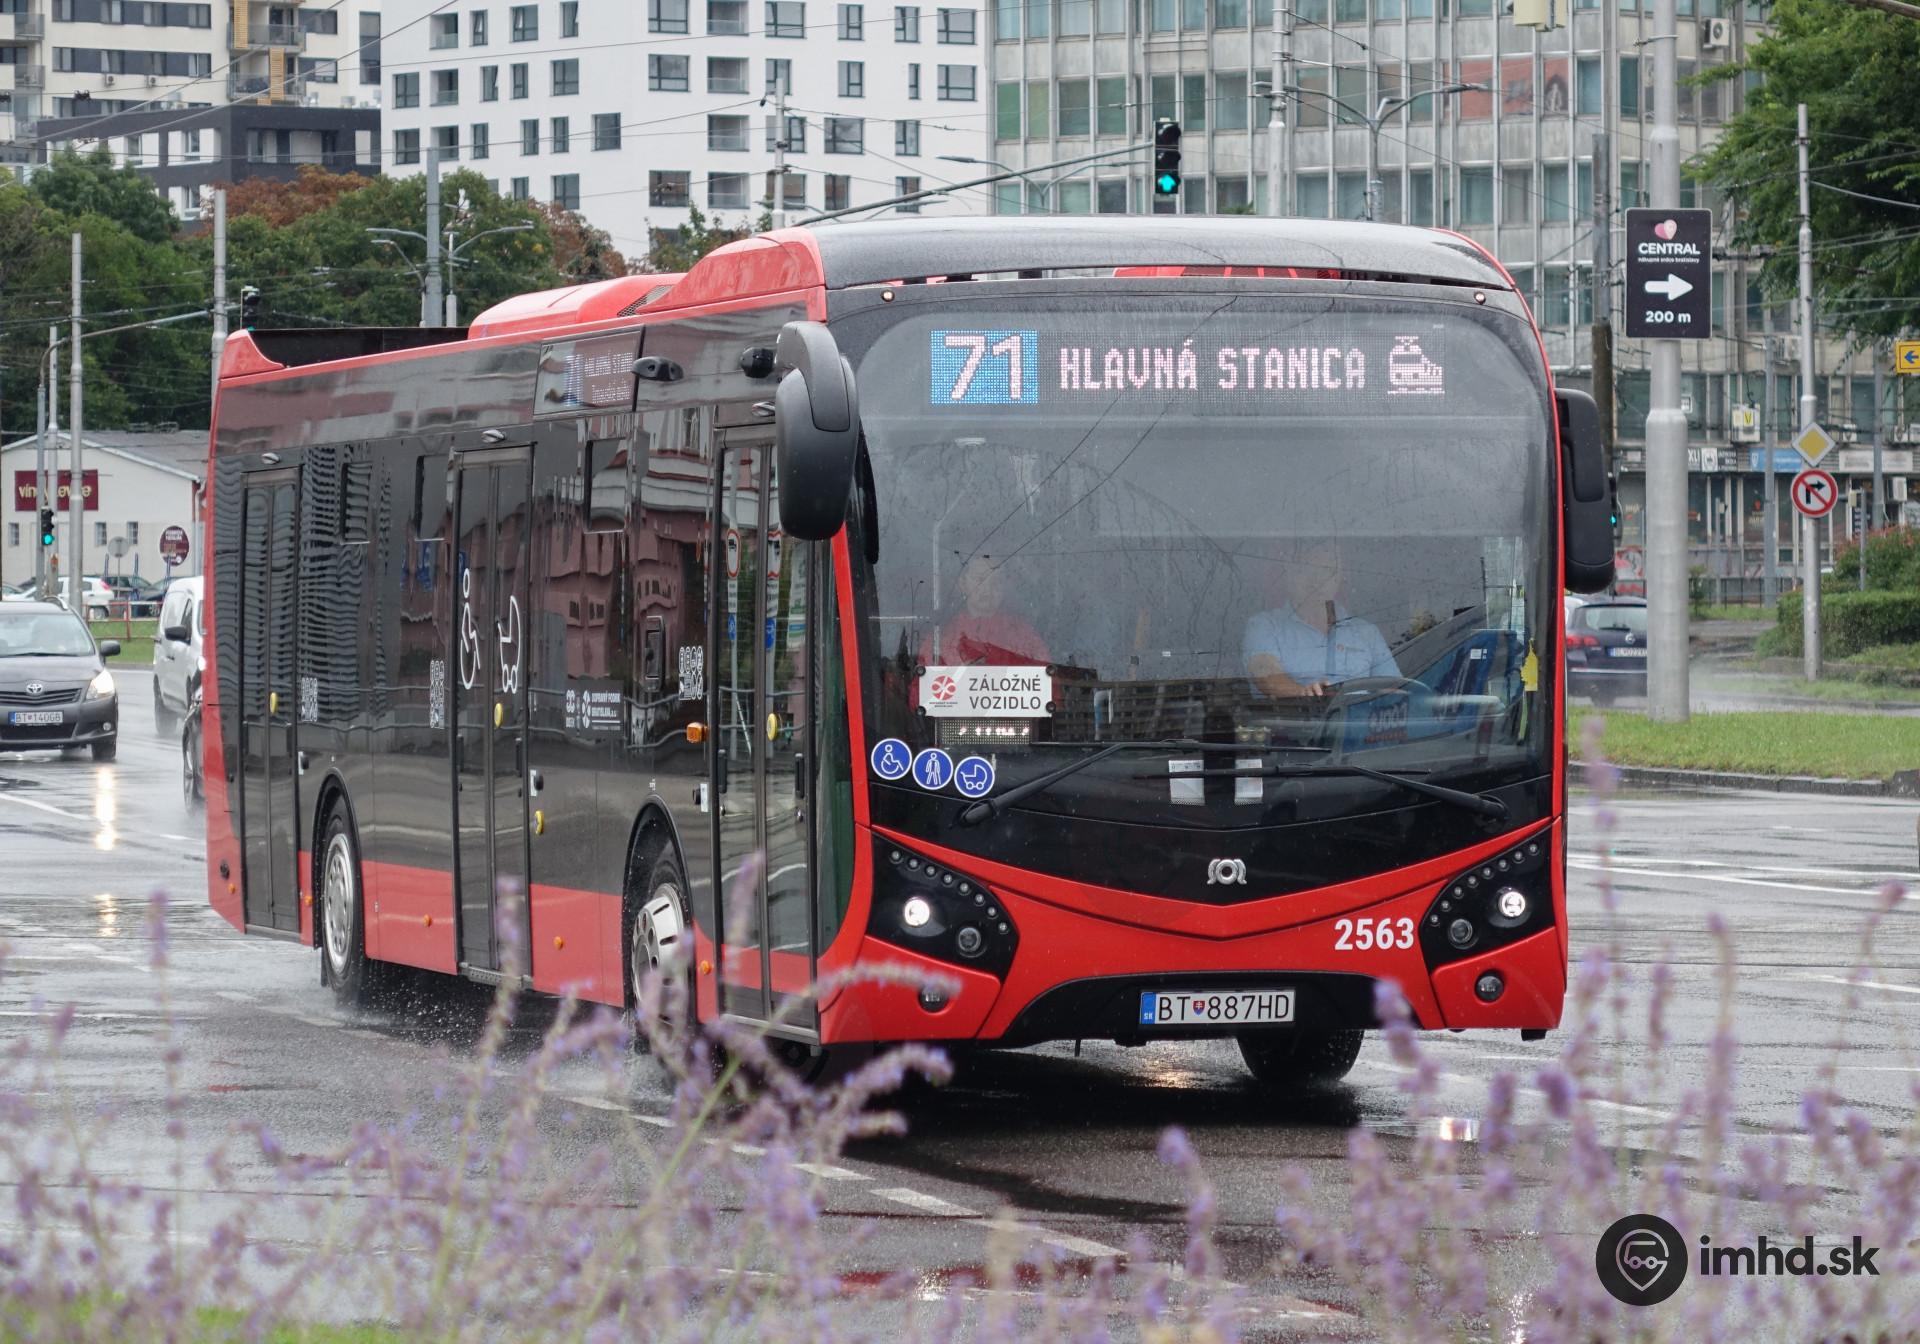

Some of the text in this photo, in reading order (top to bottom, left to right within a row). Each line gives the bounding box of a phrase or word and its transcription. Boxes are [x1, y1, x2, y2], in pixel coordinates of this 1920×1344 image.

[1638, 242, 1701, 255] CENTRAL
[1645, 310, 1691, 323] 200 m
[944, 335, 1365, 401] 71 HLAVNÁ STANICA
[969, 674, 1041, 692] ZÁLOŽNÉ
[969, 696, 1041, 710] VOZIDLO
[1334, 918, 1414, 950] 2563
[1158, 996, 1192, 1021] BT
[1207, 995, 1289, 1020] 887HD
